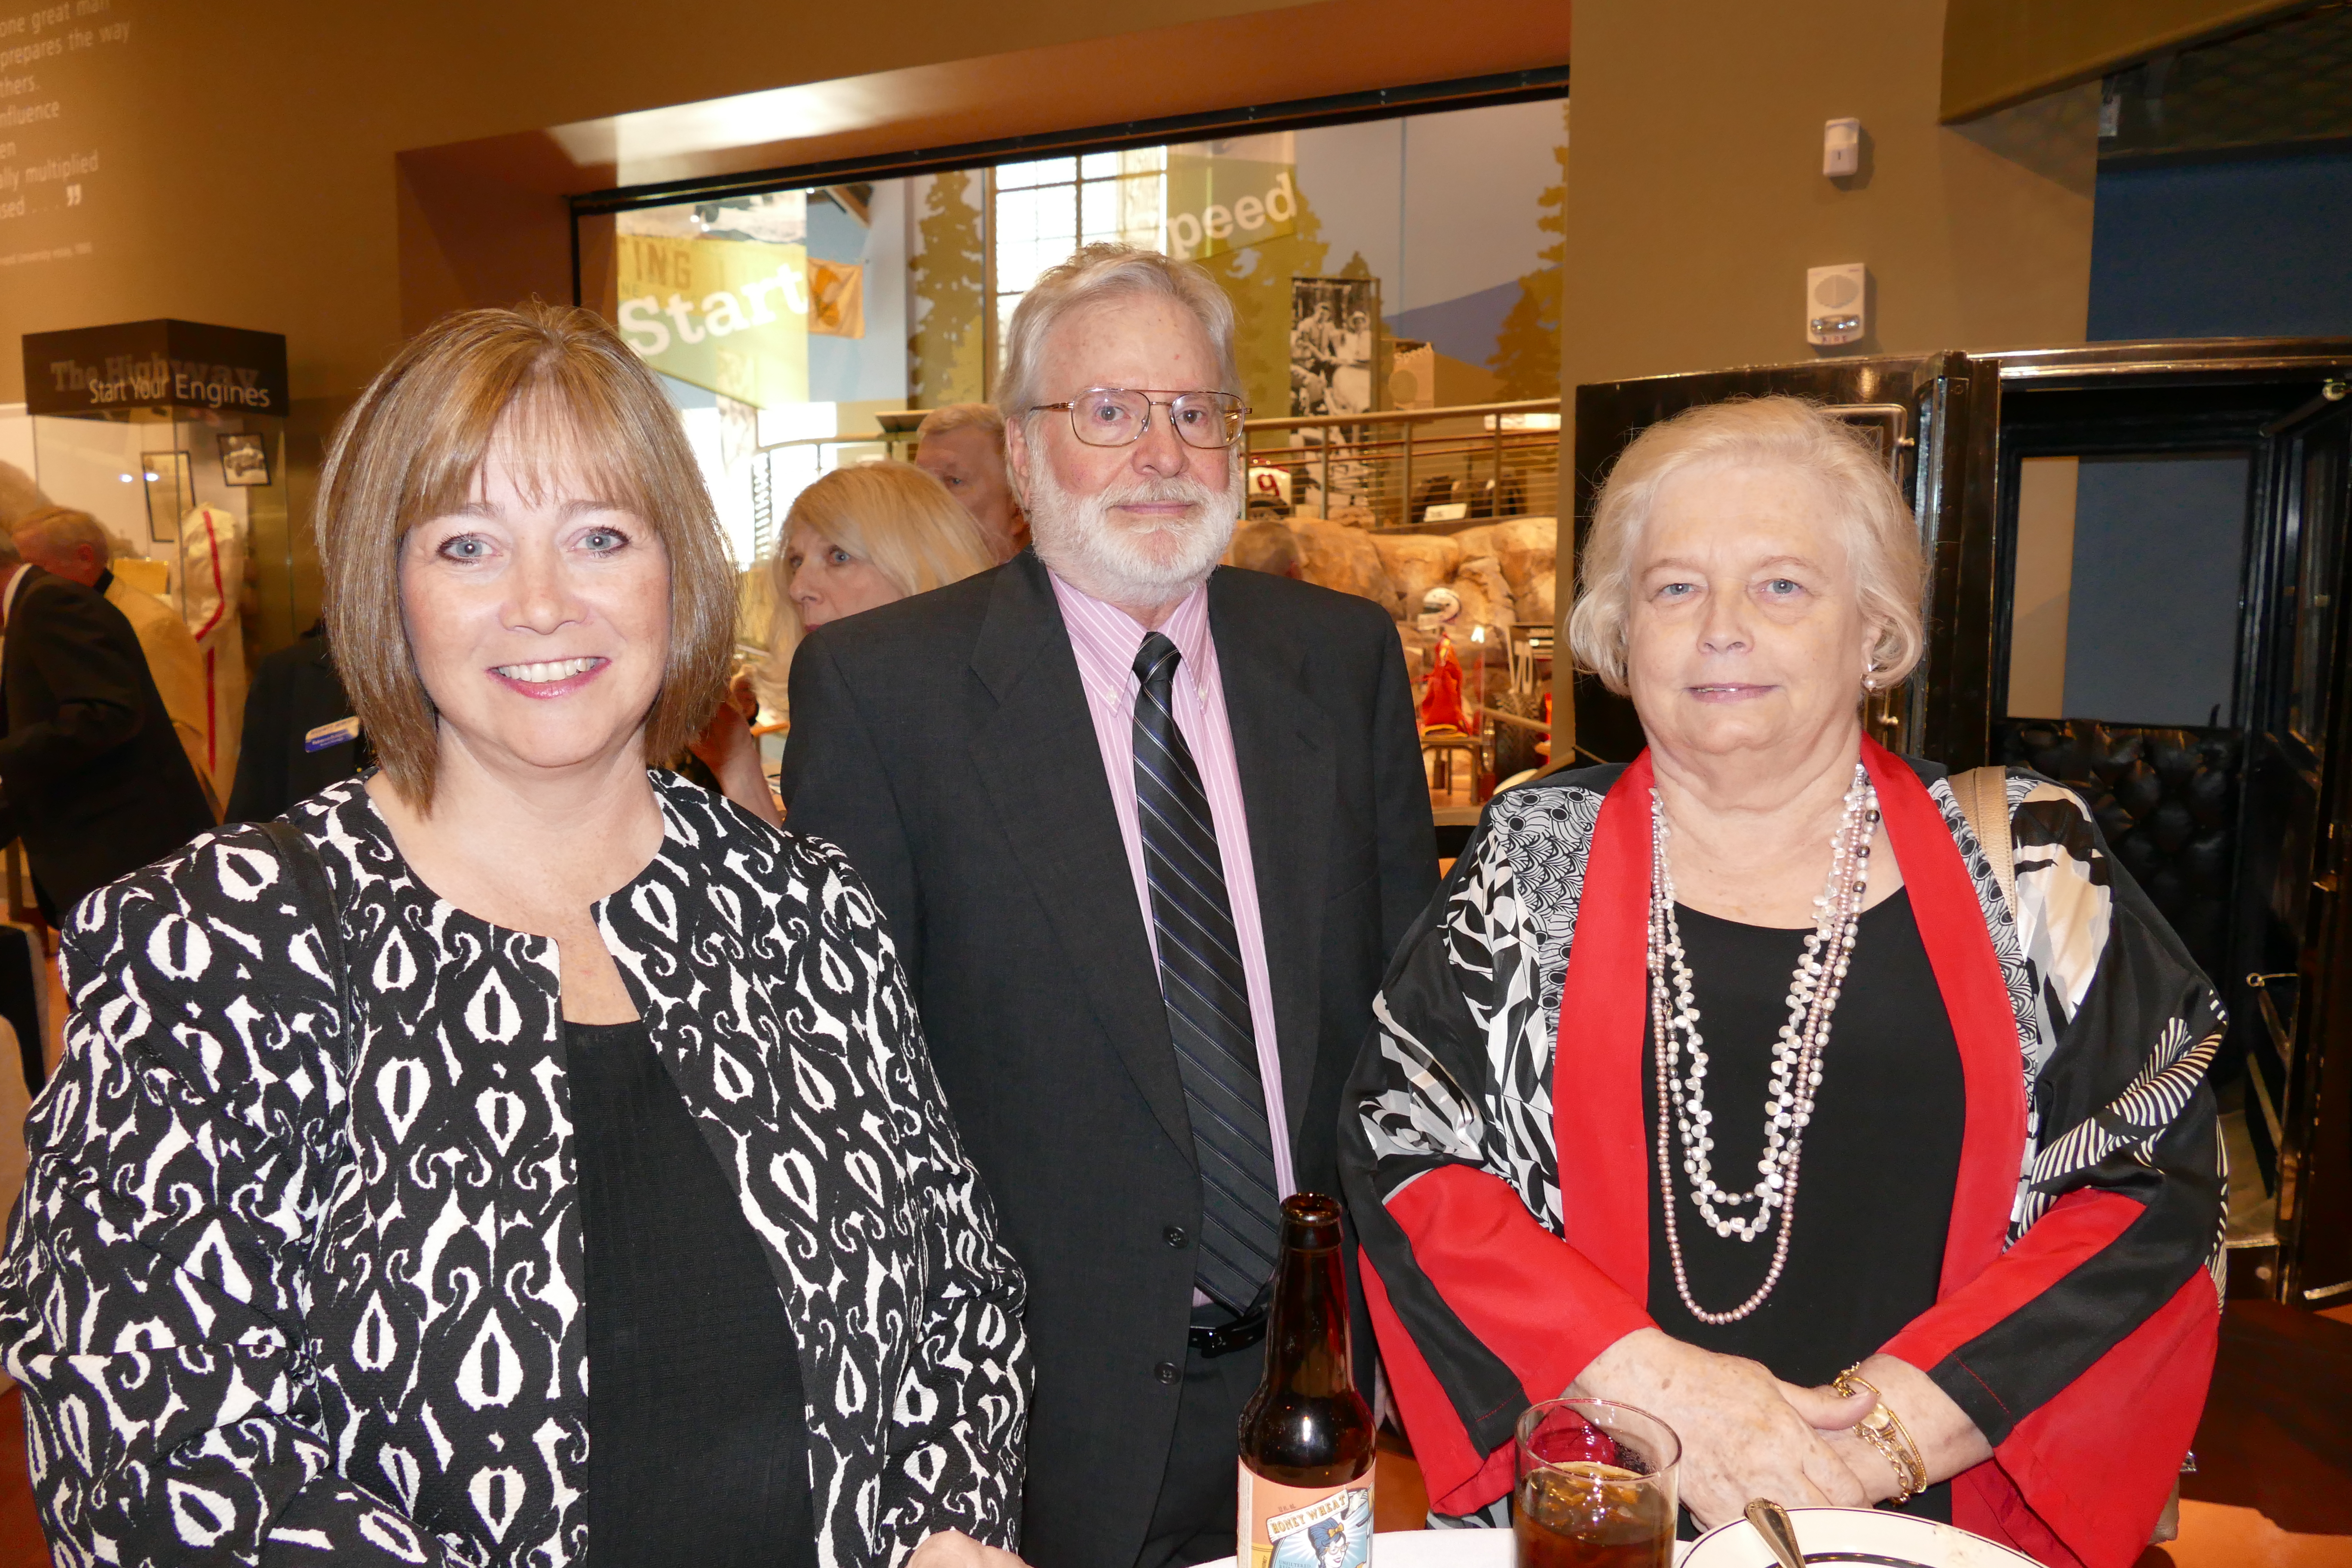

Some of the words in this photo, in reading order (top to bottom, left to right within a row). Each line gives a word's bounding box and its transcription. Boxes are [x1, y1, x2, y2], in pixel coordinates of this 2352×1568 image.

[32, 1, 70, 34] great
[0, 38, 62, 73] prepares
[67, 28, 94, 51] the
[98, 21, 129, 43] way
[25, 148, 98, 182] multiplied
[1135, 171, 1297, 263] peed
[618, 263, 808, 356] Start
[50, 359, 98, 392] The
[89, 379, 127, 404] Start
[129, 377, 170, 400] Your
[175, 373, 270, 408] Engines
[1271, 1514, 1305, 1534] HONEY
[1307, 1495, 1346, 1520] WHEAT
[1279, 1559, 1311, 1568] UNFILTERED
